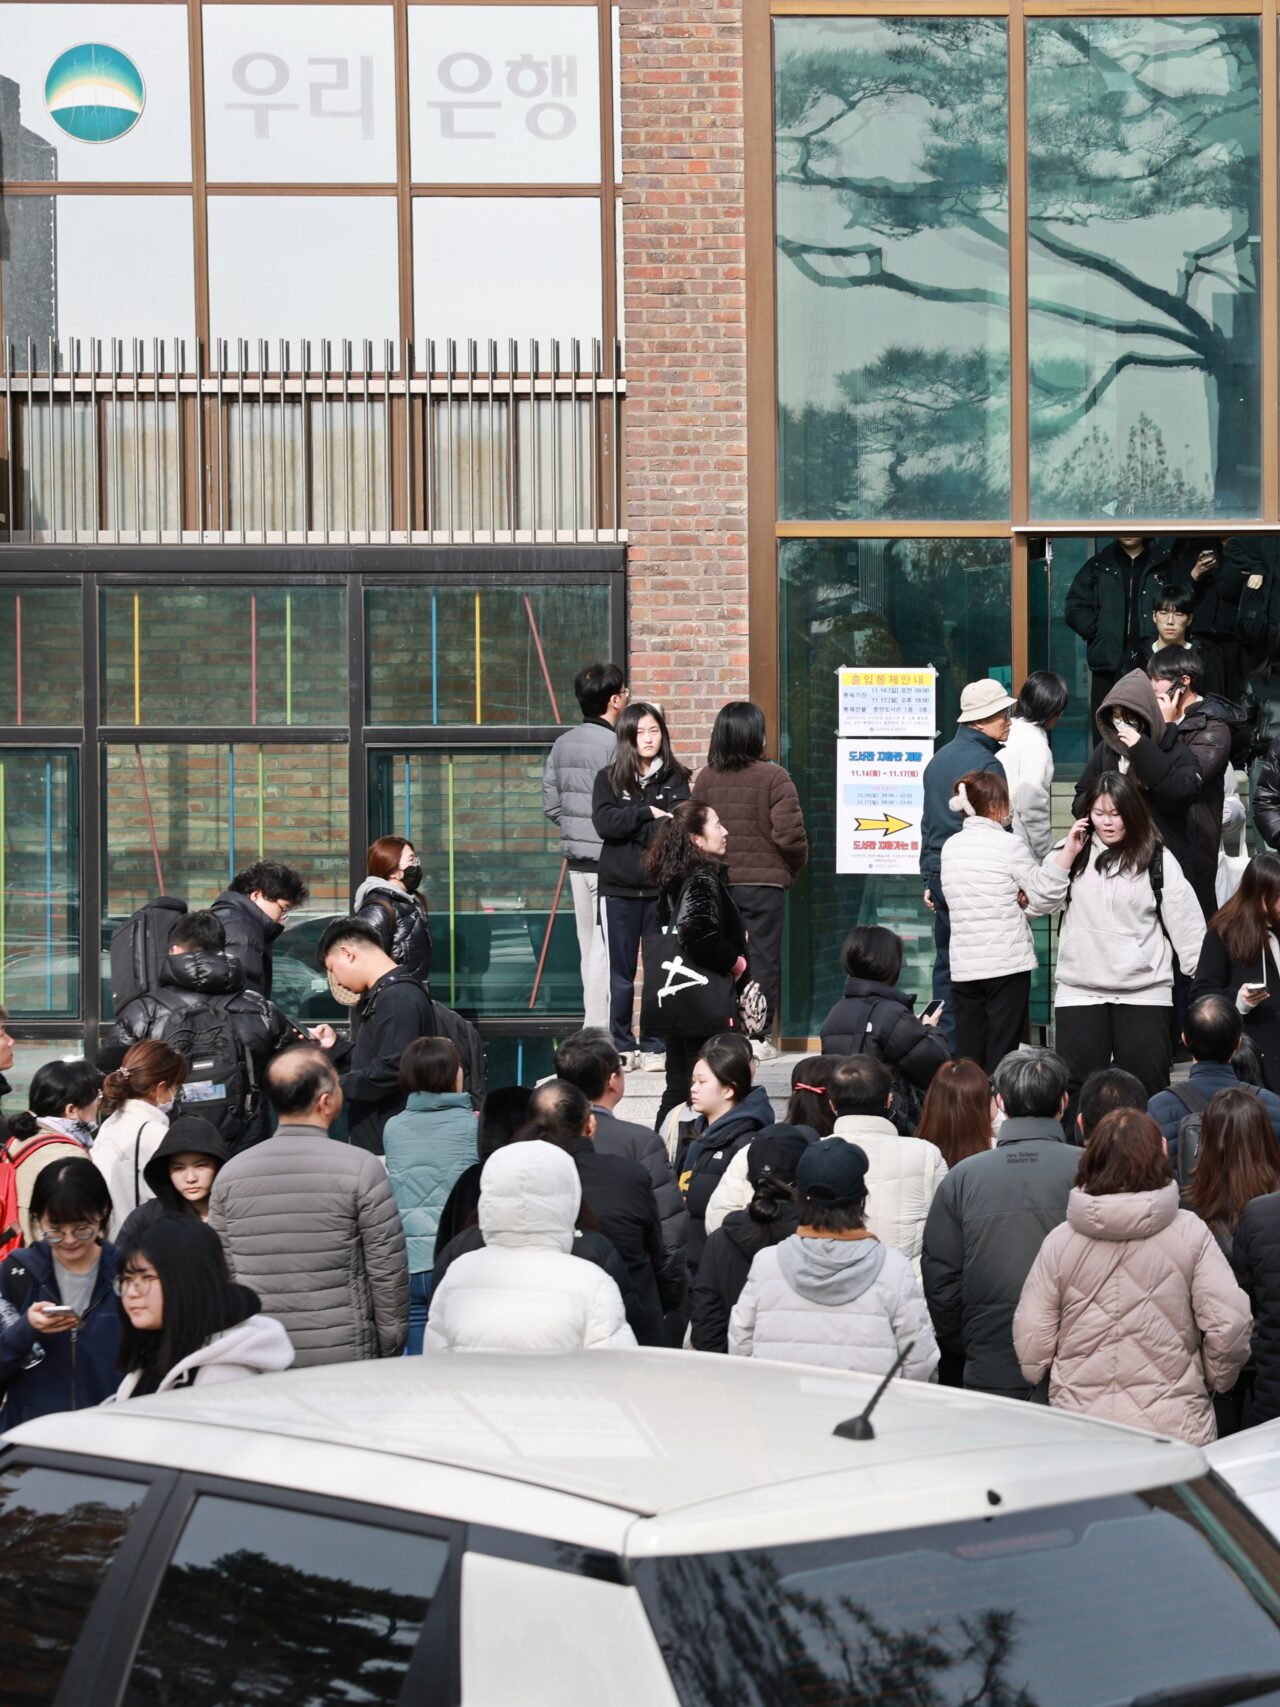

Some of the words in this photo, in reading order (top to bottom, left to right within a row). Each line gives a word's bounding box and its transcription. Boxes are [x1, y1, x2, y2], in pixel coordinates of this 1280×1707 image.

[225, 52, 375, 140] 우리
[427, 52, 578, 140] 은행
[852, 675, 924, 685] 출입통제안내
